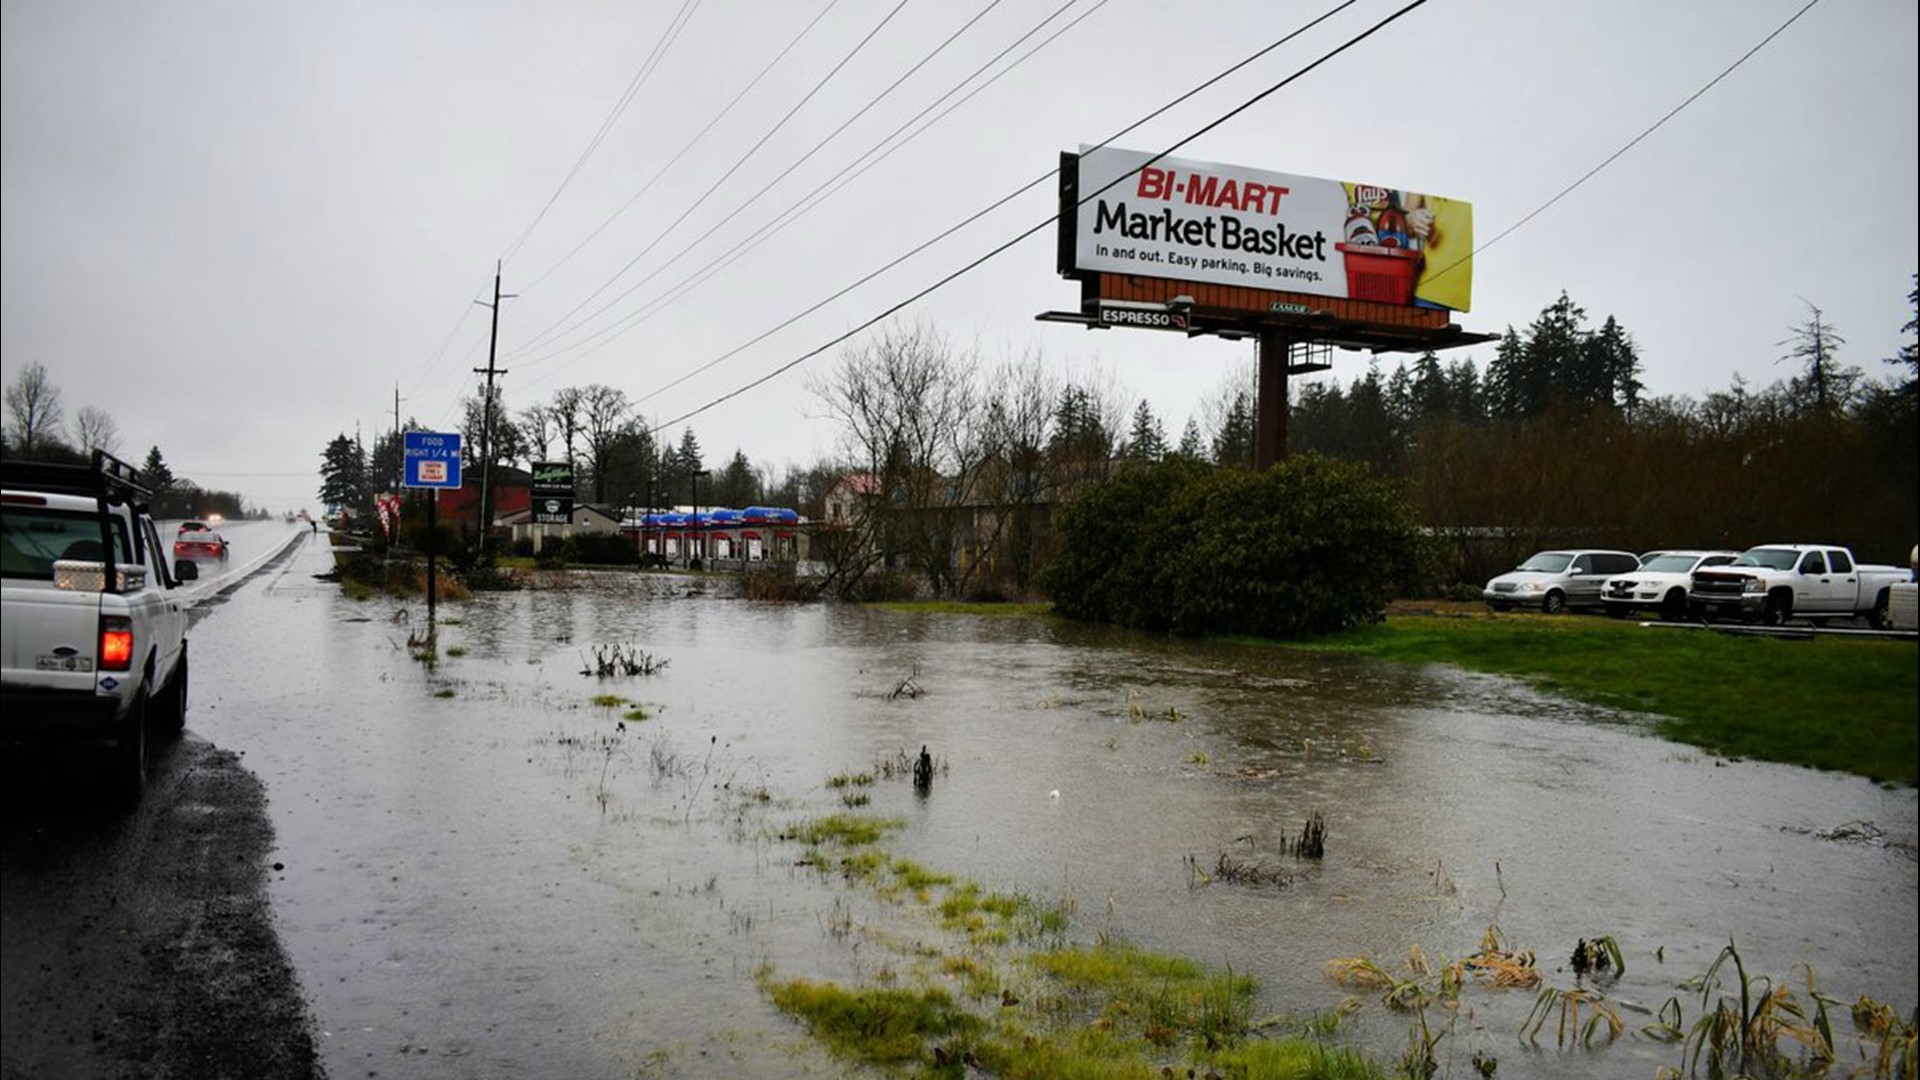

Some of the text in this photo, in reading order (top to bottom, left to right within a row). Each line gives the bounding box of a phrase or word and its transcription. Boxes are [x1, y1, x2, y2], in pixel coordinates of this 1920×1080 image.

[1096, 244, 1323, 282] In and out. Easy parking. Big savings.
[1102, 309, 1170, 326] ESPRESSO
[422, 436, 444, 447] FOOD
[536, 513, 569, 523] STORAGE
